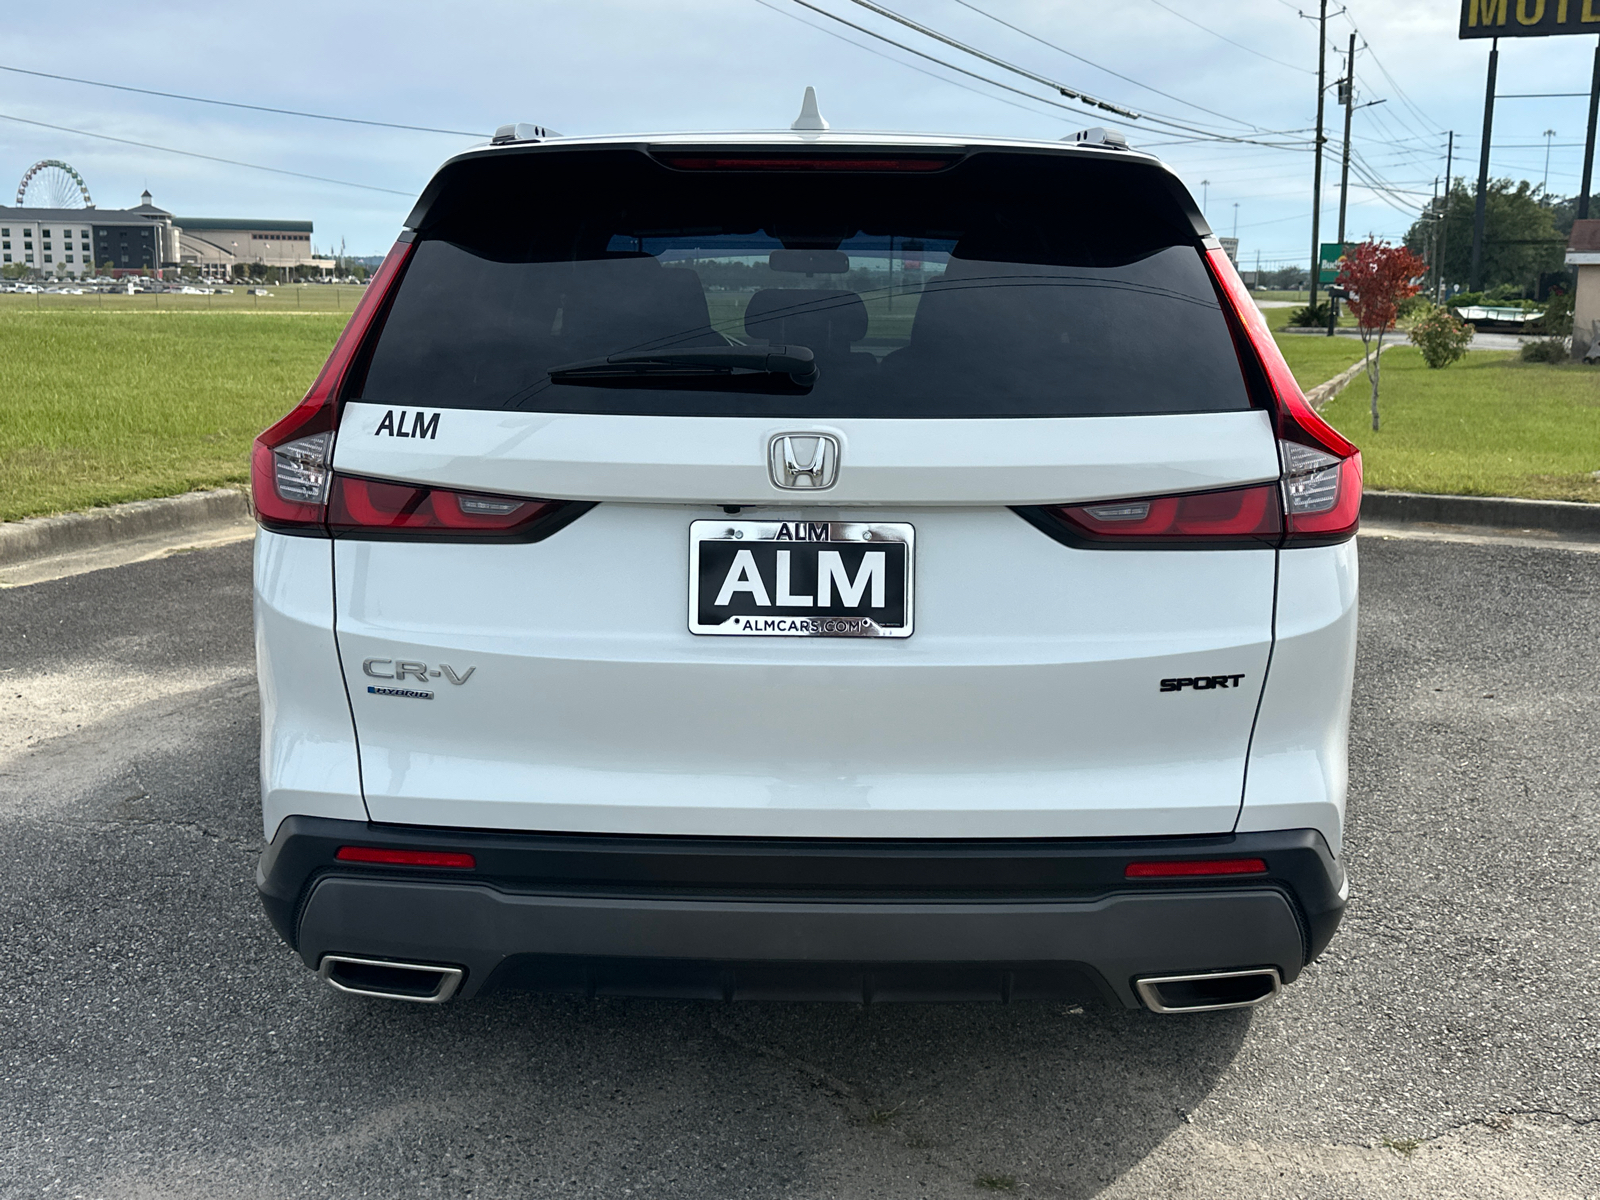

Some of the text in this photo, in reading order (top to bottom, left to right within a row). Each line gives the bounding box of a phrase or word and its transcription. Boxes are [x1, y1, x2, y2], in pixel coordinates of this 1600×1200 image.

[374, 410, 441, 439] ALM
[775, 522, 830, 541] ALM
[713, 549, 886, 608] ALM
[742, 619, 861, 633] ALMCARS.COM
[362, 656, 477, 685] CR-V
[1160, 673, 1245, 692] SPORT
[376, 687, 430, 699] HYBRID
